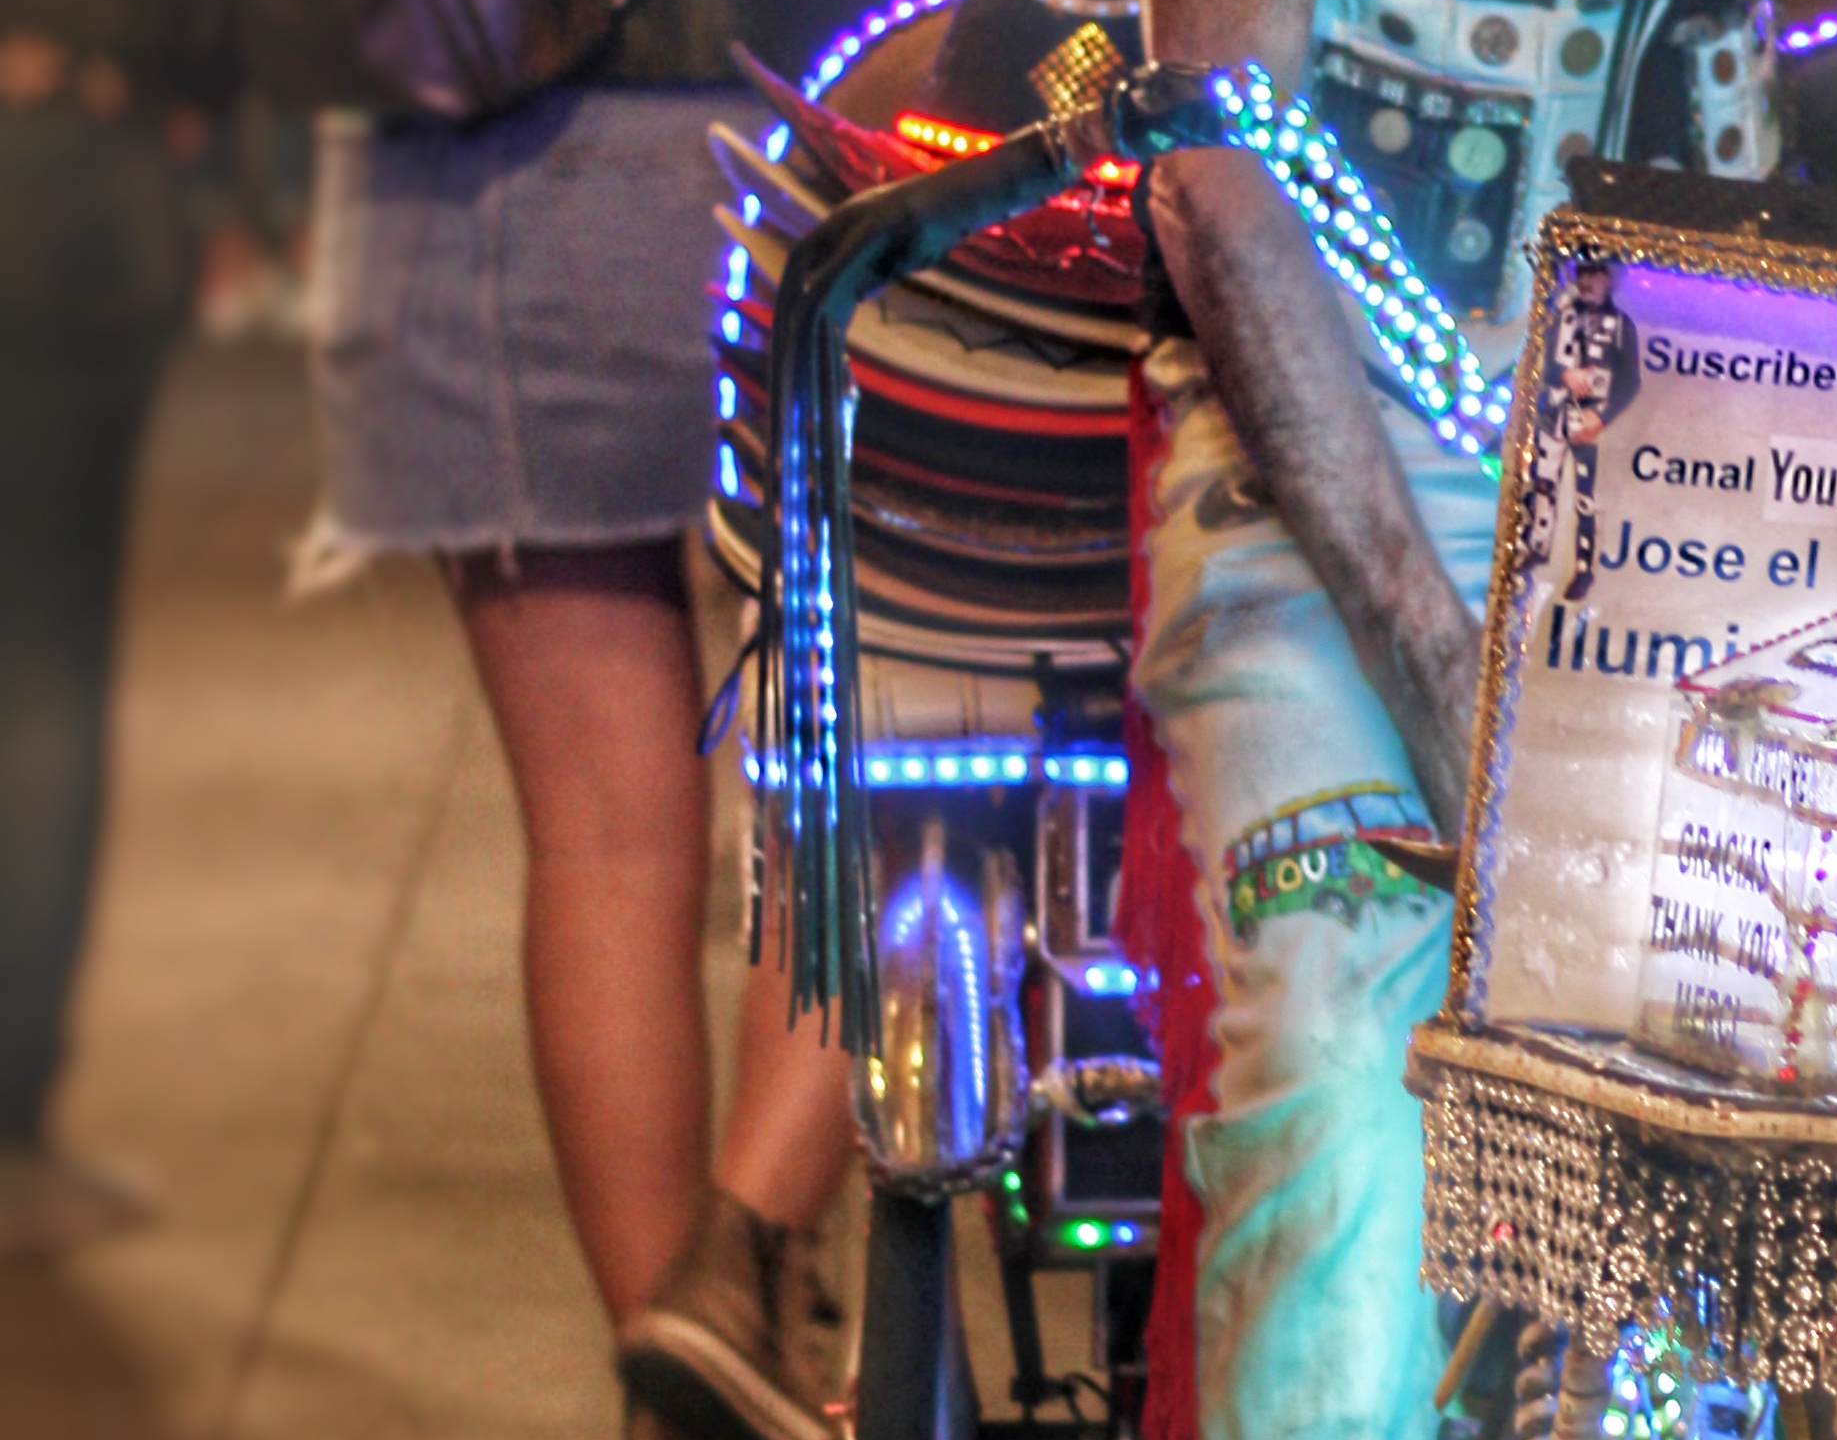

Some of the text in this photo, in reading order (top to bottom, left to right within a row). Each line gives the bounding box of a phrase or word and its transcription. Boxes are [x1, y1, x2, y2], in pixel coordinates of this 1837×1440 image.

[1631, 445, 1755, 492] Canal
[1600, 520, 1746, 581] Jose
[1767, 539, 1819, 589] el
[1546, 603, 1764, 678] Ilumi
[1257, 842, 1353, 900] LOVE
[1678, 822, 1771, 893] GRACIAS
[1651, 894, 1723, 965] THANK
